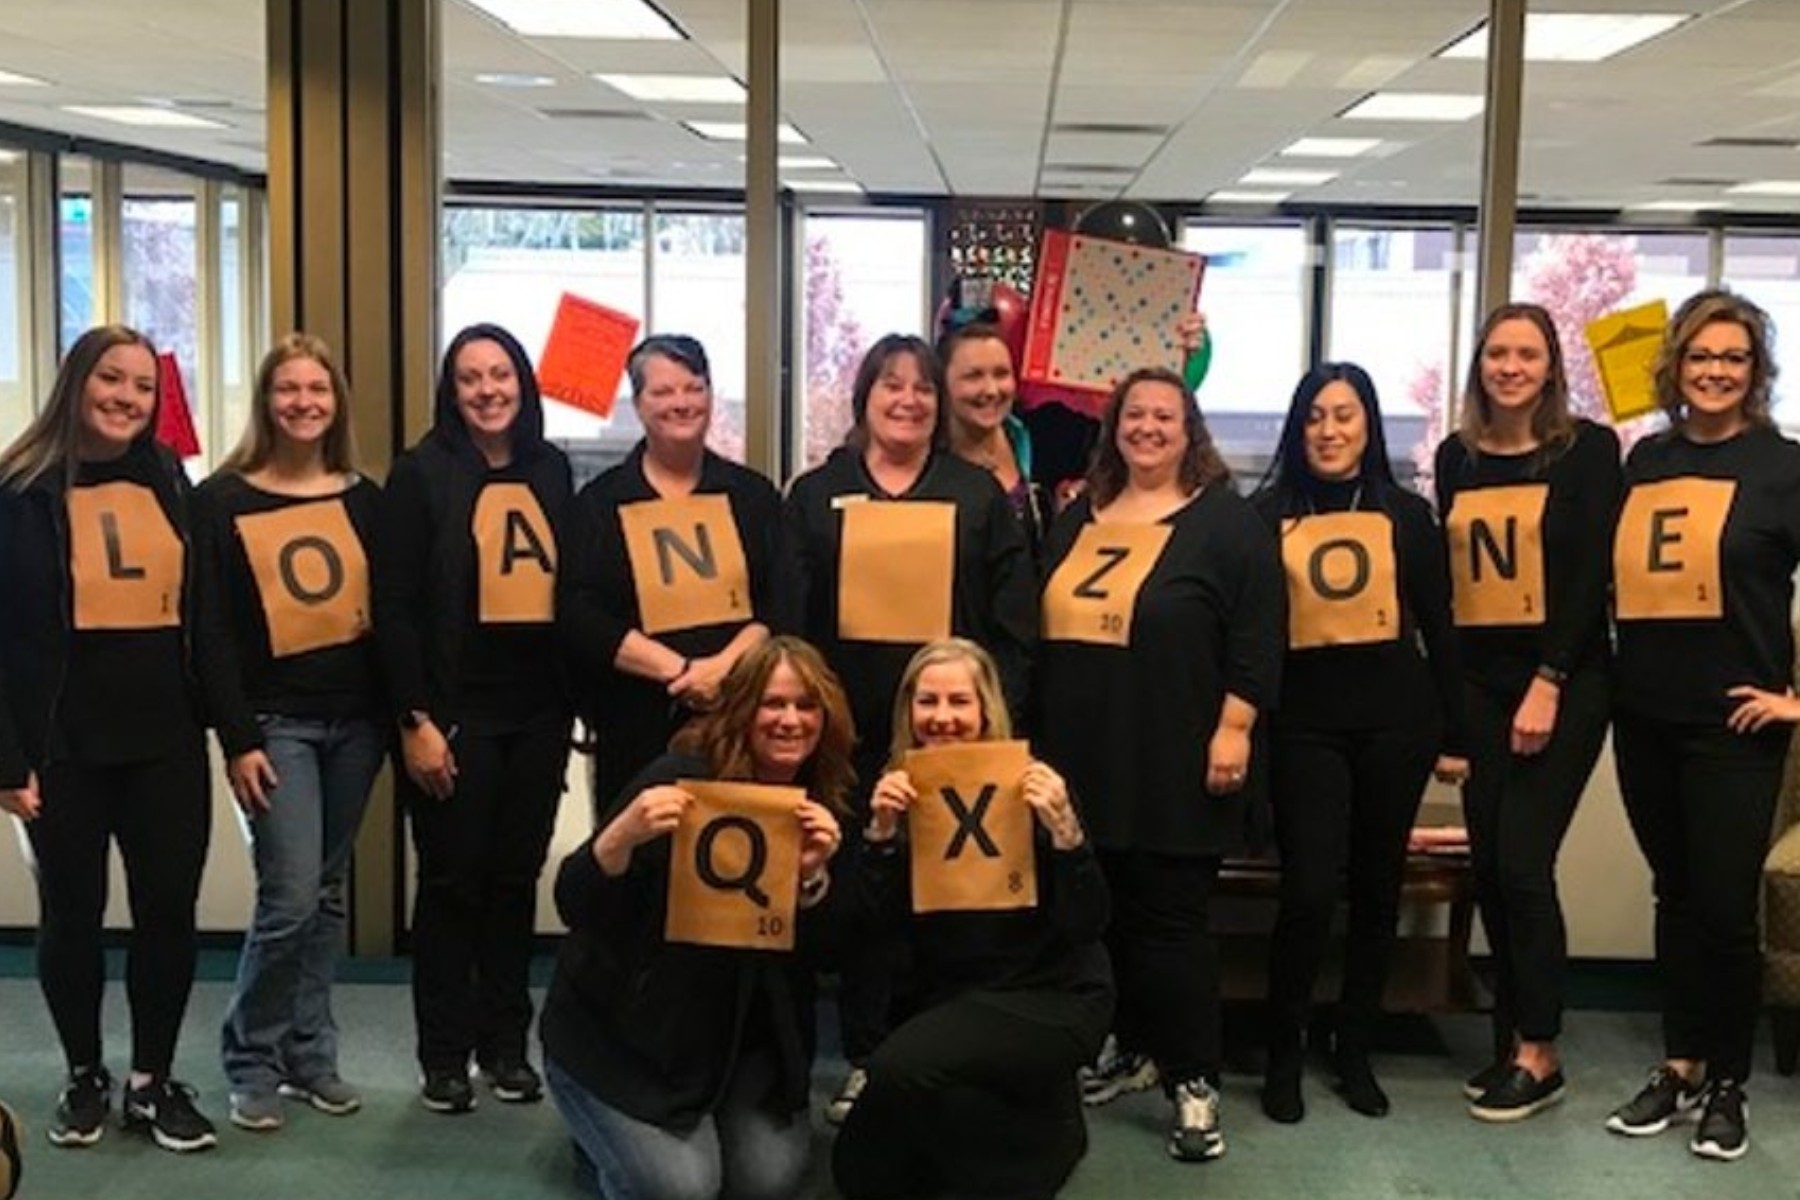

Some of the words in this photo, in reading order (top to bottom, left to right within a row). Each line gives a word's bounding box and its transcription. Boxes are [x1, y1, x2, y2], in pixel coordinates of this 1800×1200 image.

[102, 512, 145, 580] L
[500, 510, 554, 575] A
[653, 523, 716, 585] N
[1468, 516, 1517, 582] N
[1648, 508, 1689, 573] E
[279, 536, 344, 604] O
[1073, 547, 1130, 598] Z
[1308, 538, 1370, 600] O
[1697, 584, 1707, 602] 1
[161, 594, 168, 613] 1
[729, 588, 739, 608] 1
[1101, 613, 1123, 631] 10
[1378, 609, 1387, 627] 1
[1524, 595, 1533, 614] 1
[940, 785, 1001, 859] X
[695, 815, 770, 909] Q
[1008, 872, 1022, 894] 8
[756, 916, 782, 937] 10
